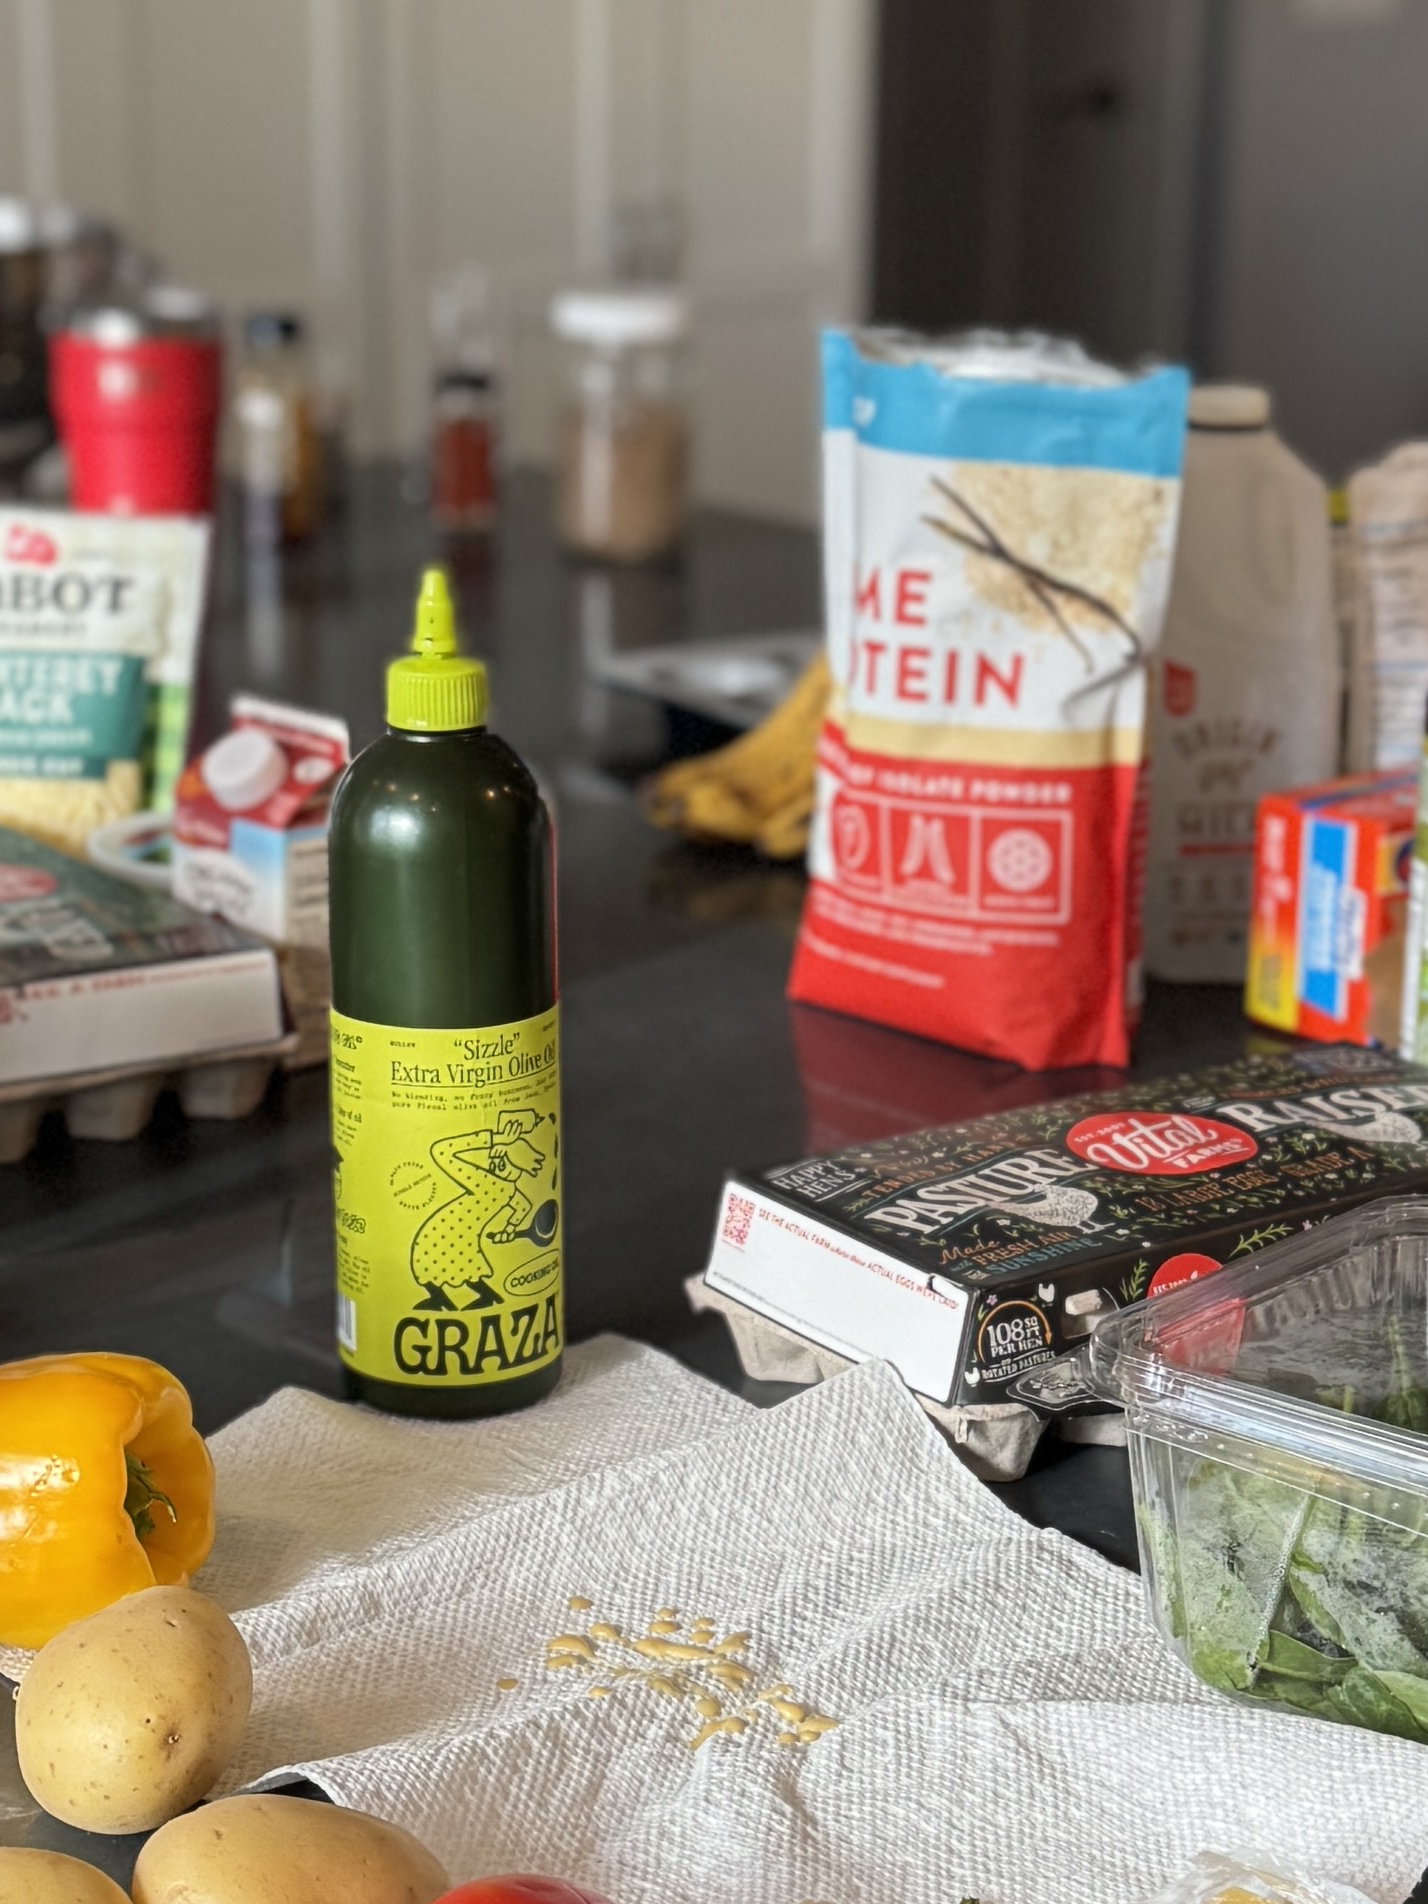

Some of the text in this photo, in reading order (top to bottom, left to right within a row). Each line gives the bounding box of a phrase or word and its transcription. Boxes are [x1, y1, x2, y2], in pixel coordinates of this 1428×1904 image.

[971, 779, 1071, 804] POWDER
[391, 1061, 441, 1083] Extra
[447, 1062, 503, 1088] Virgin
[509, 1054, 541, 1077] Olive
[1086, 1114, 1218, 1170] Vital
[1170, 1138, 1242, 1169] FARMS
[773, 1160, 841, 1191] HAPPY
[796, 1171, 856, 1199] HENS
[862, 1161, 962, 1198] TENDED BY
[863, 1148, 1091, 1234] PASTURE
[1163, 1180, 1225, 1208] LARGE
[1227, 1169, 1278, 1193] EGGS
[1279, 1150, 1352, 1179] GRADE
[1350, 1147, 1375, 1164] A
[758, 1208, 770, 1222] SEE
[772, 1215, 784, 1229] THE
[785, 1221, 811, 1241] ACTUAL
[811, 1232, 830, 1250] FARM
[867, 1263, 895, 1281] ACTUAL
[896, 1274, 915, 1291] EGGS
[939, 1240, 1000, 1265] Made
[971, 1231, 1074, 1266] FRESH AIR
[987, 1237, 1102, 1276] SUNSHINE
[394, 1293, 559, 1376] GRAZA
[987, 1319, 1024, 1347] 108
[1024, 1316, 1038, 1326] SQ
[991, 1336, 1043, 1358] PER HEN
[982, 1350, 1055, 1379] ROTATED PASTURES
